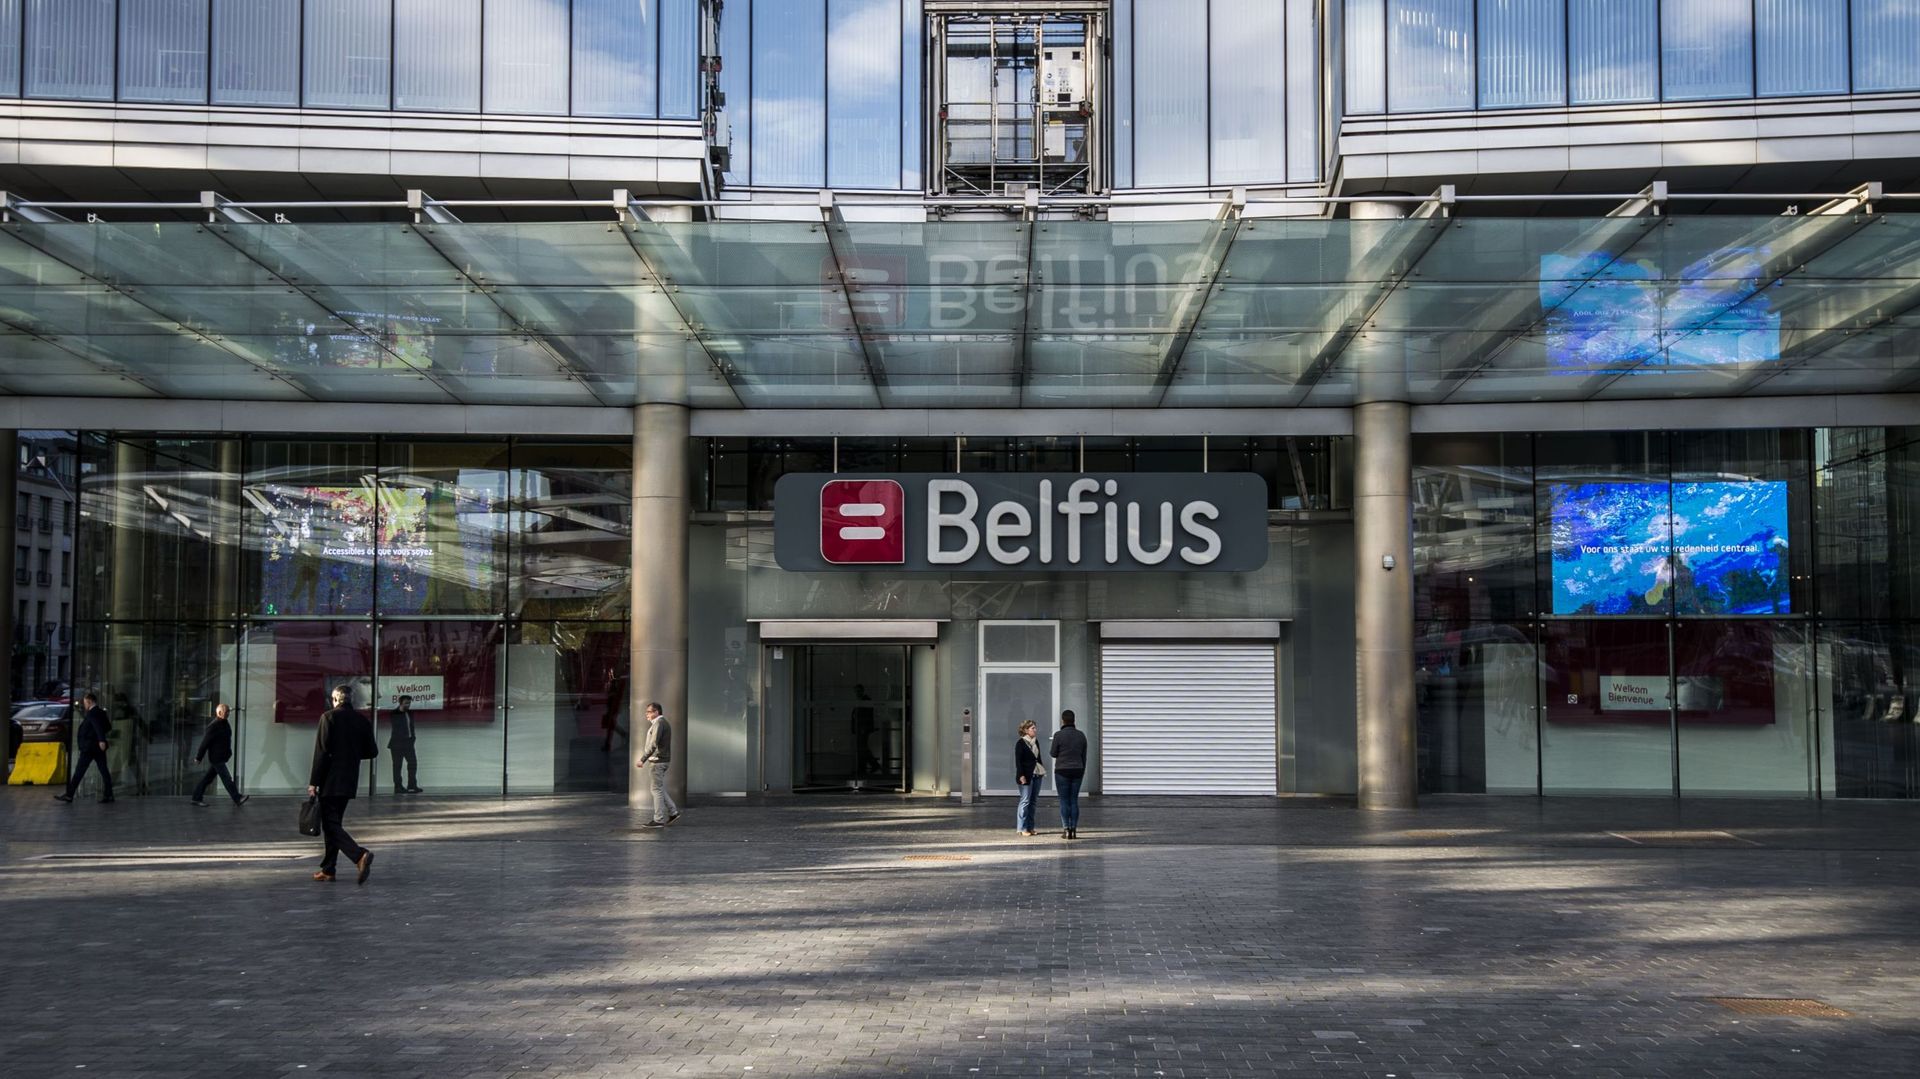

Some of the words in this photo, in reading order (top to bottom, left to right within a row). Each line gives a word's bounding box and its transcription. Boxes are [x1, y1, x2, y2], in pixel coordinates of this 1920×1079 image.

[927, 478, 1221, 565] Belfius
[323, 547, 365, 556] Accessibles
[378, 548, 392, 557] que
[393, 548, 410, 556] vous
[1580, 545, 1600, 554] Voor
[1620, 545, 1643, 553] staat
[1720, 544, 1760, 552] centraal.
[397, 684, 431, 693] Welkom
[1613, 683, 1648, 694] Welkom
[392, 693, 436, 704] Bivenue
[1609, 692, 1654, 704] Bienvenue
